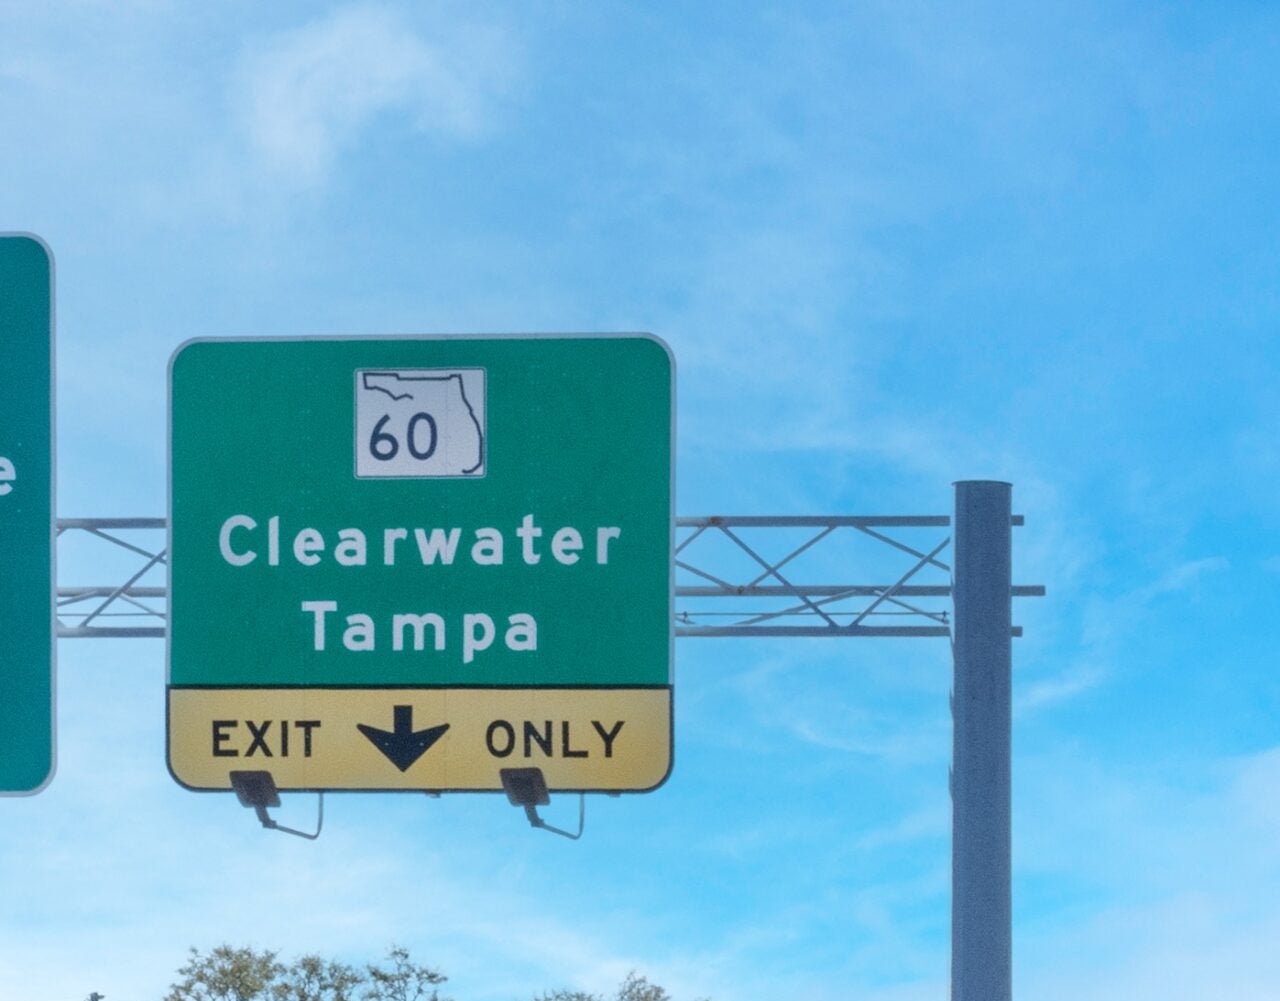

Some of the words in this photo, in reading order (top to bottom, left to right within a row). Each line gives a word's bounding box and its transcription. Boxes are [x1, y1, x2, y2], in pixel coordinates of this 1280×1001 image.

[369, 411, 438, 462] 60
[219, 514, 621, 567] Clearwater
[301, 600, 538, 664] Tampa
[212, 719, 322, 758] EXIT
[485, 719, 625, 759] ONLY
